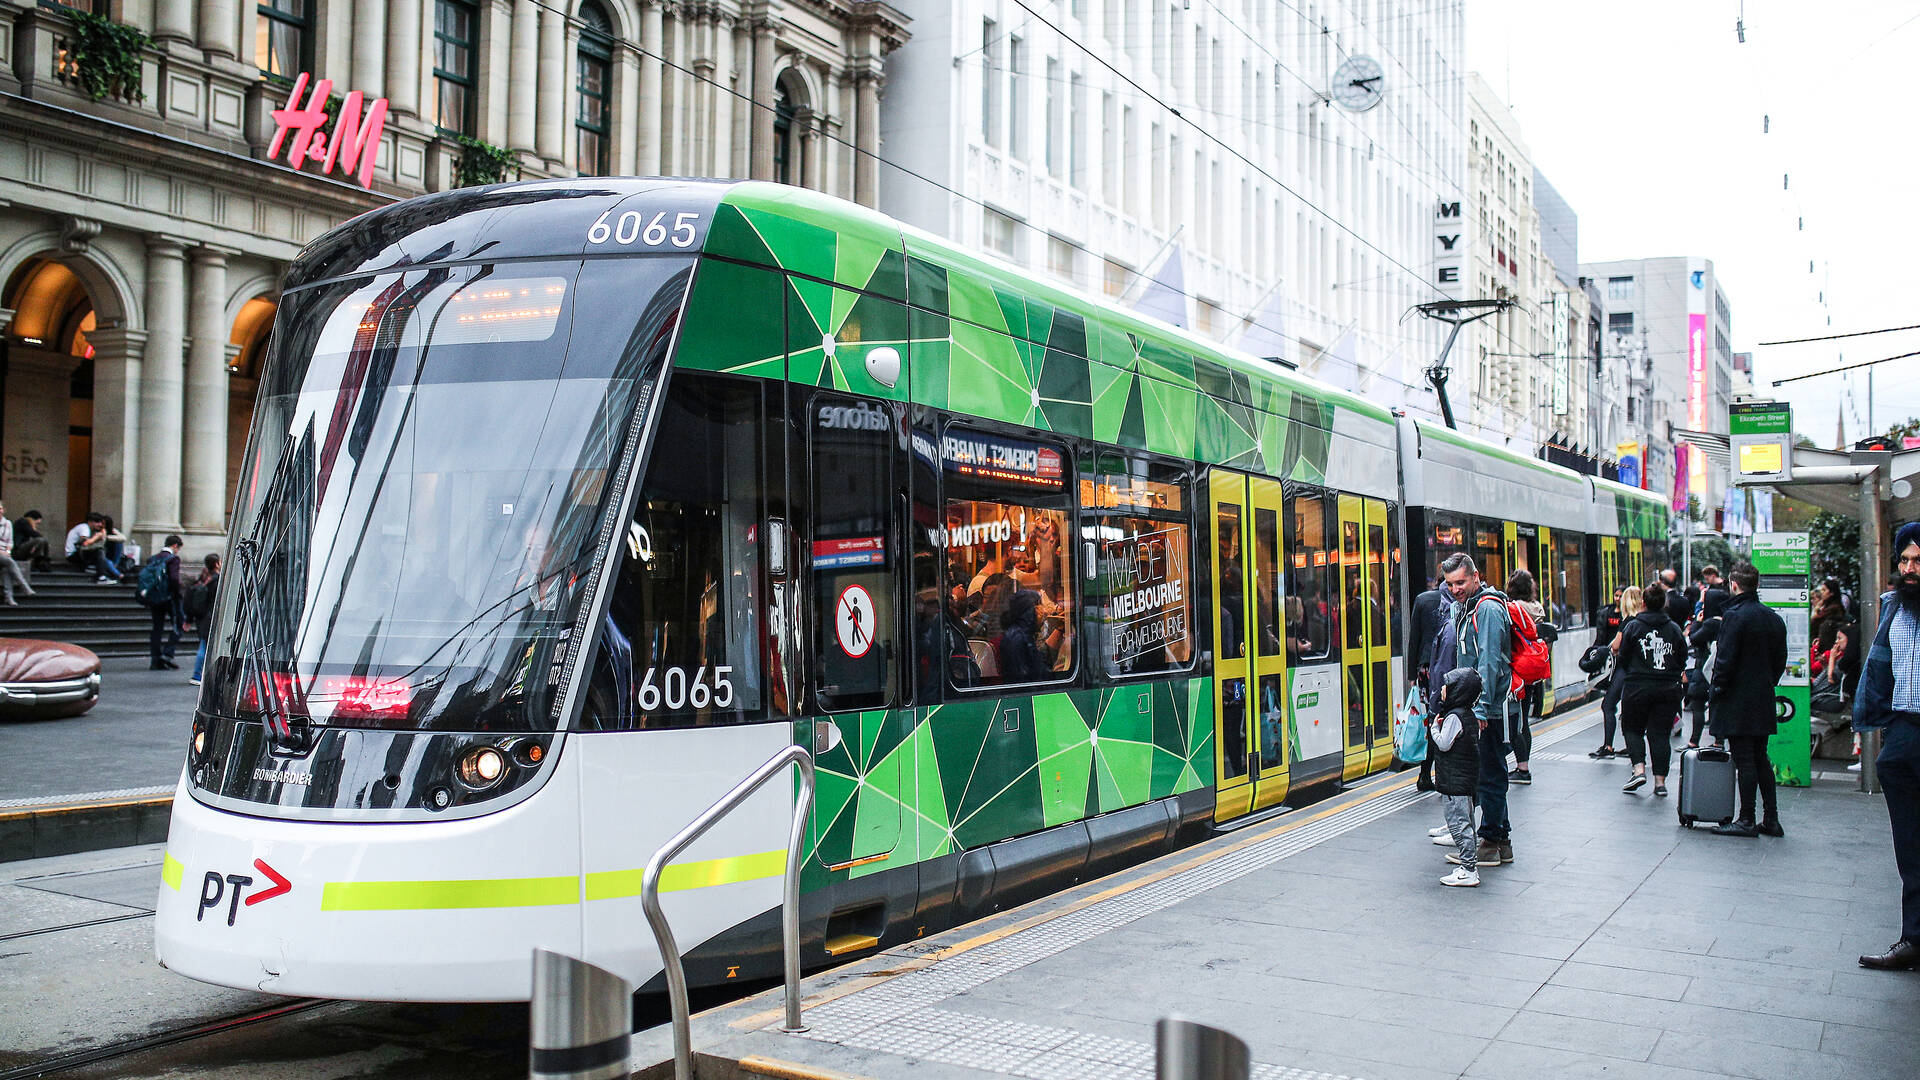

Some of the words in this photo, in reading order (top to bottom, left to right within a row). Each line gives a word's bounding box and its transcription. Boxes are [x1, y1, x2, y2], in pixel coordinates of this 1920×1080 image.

[266, 71, 389, 190] H&M
[587, 210, 700, 248] 6065
[1437, 202, 1460, 314] MYE
[1740, 415, 1767, 423] Elizabeth
[4, 455, 49, 475] GPO
[1110, 539, 1163, 591] MADE
[1164, 535, 1181, 577] IN
[1113, 579, 1182, 620] MELBOURNE
[1800, 592, 1808, 601] 5
[1115, 630, 1135, 654] FOR
[1135, 613, 1184, 648] MELBOURNE
[638, 666, 733, 711] 6065
[253, 768, 313, 786] BOMBARDIER
[197, 870, 253, 927] PT
